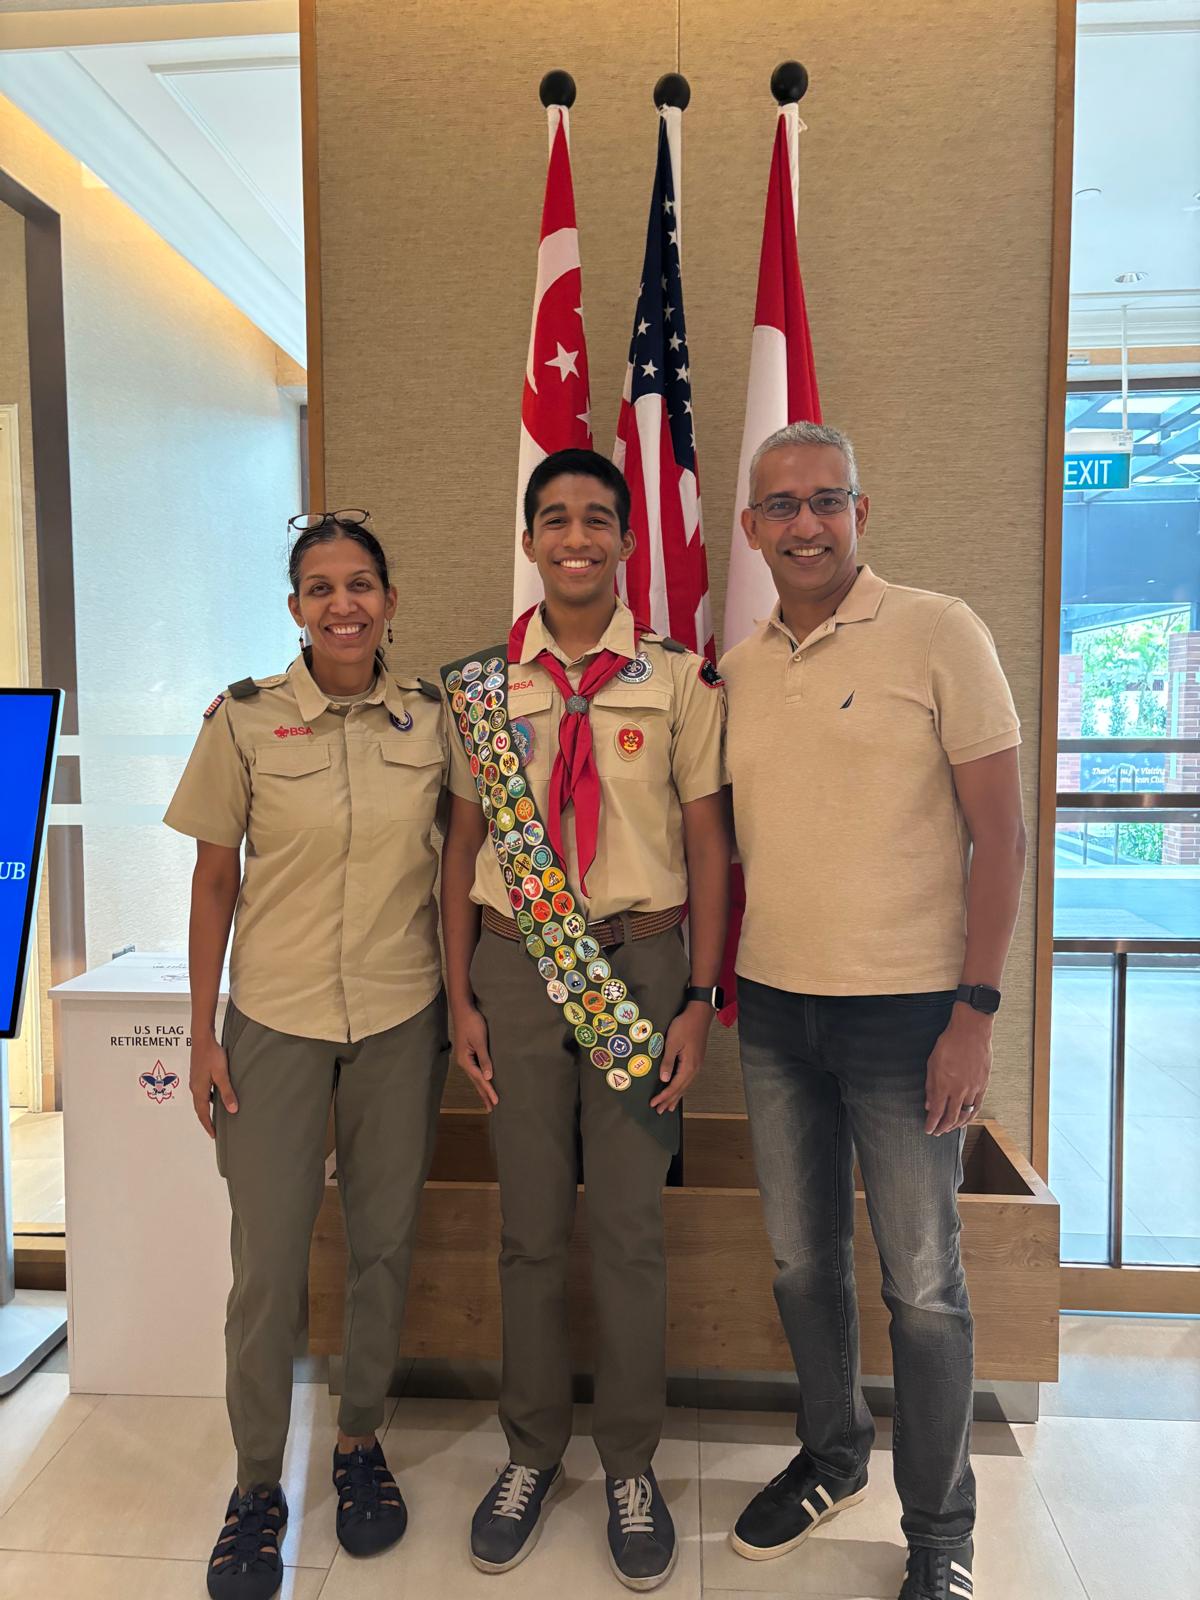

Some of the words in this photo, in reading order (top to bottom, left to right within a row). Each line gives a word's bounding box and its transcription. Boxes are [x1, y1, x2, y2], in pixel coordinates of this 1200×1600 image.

[1065, 460, 1112, 485] EXIT
[513, 680, 534, 691] BSA
[290, 726, 314, 736] BSA
[134, 1025, 151, 1035] U.S
[156, 1025, 184, 1035] FLAG
[110, 1036, 180, 1047] RETIREMENT
